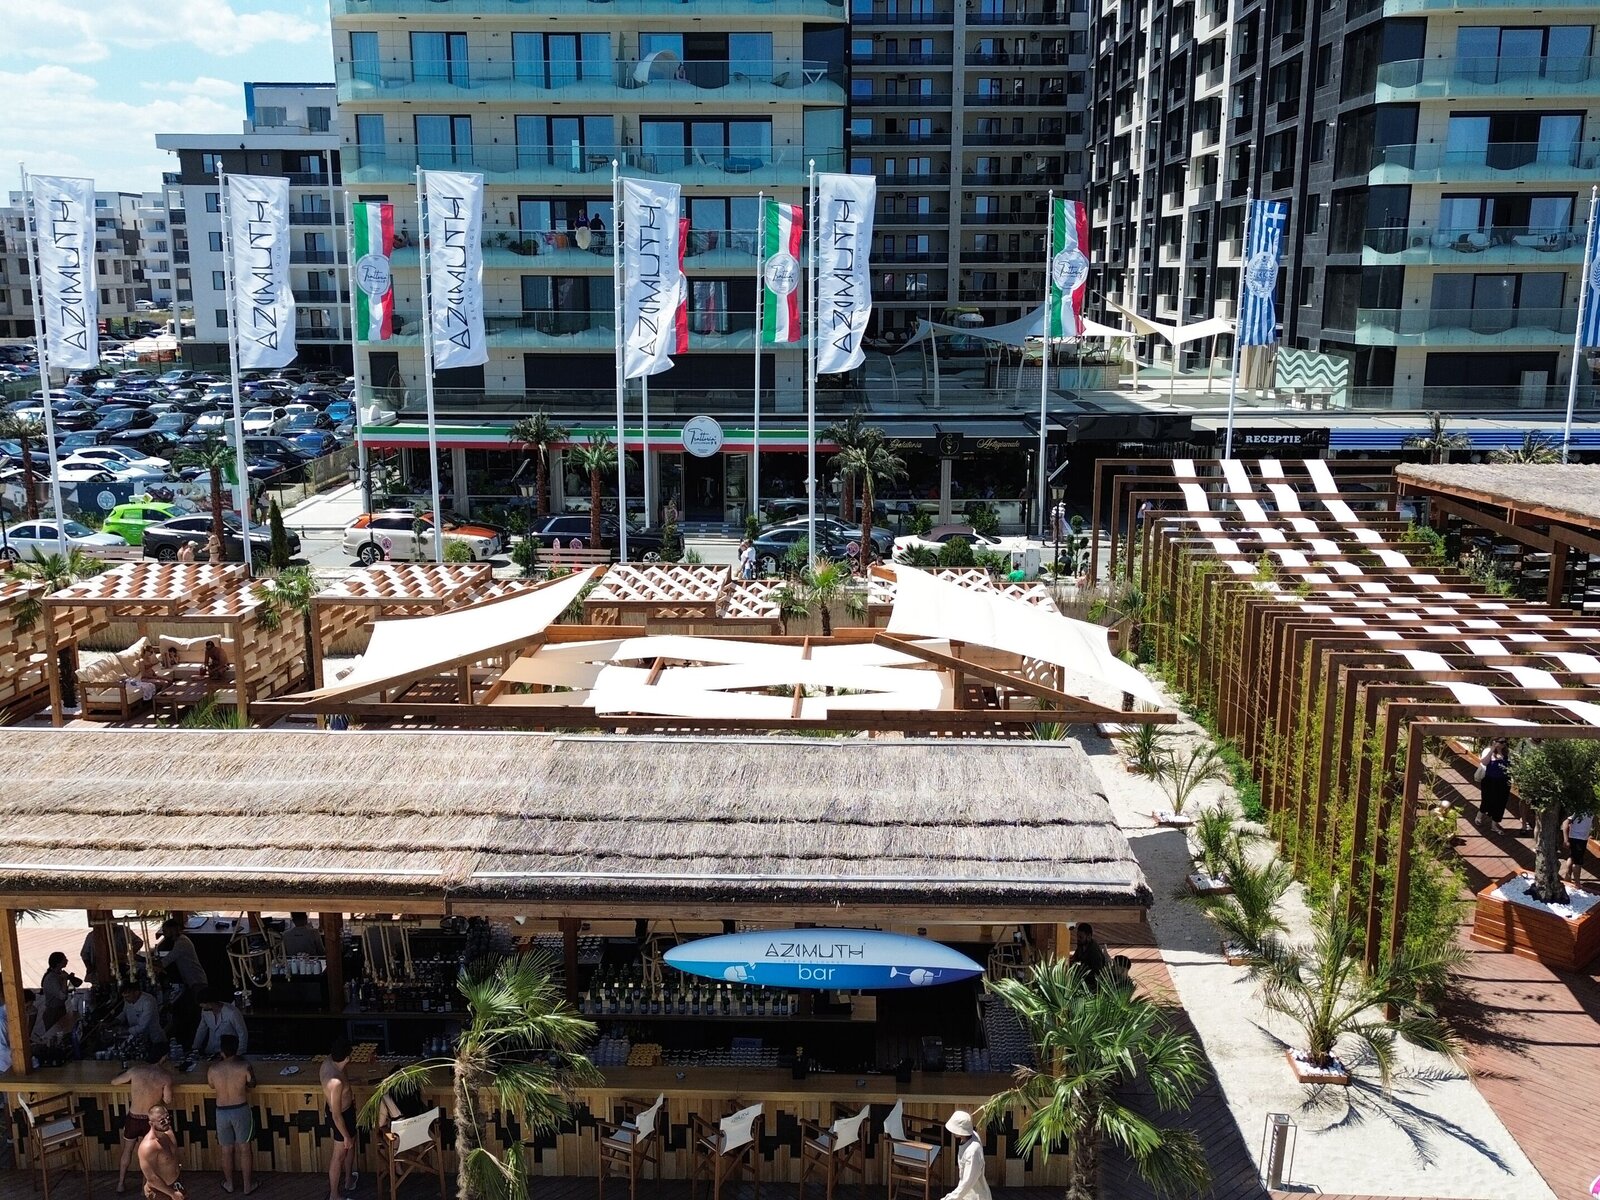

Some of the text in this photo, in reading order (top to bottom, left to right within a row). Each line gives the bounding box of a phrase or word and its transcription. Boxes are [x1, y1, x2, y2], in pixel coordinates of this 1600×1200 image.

[51, 199, 88, 351] AZIMUTH
[247, 199, 278, 351] AZIMUTH
[443, 196, 472, 350] AZIMUTH
[638, 204, 661, 357] AZIMUTH
[832, 199, 855, 354] AZIMUTH
[1245, 435, 1302, 444] RECEPTIE
[765, 942, 864, 958] AZIMUTH
[798, 964, 836, 981] bar
